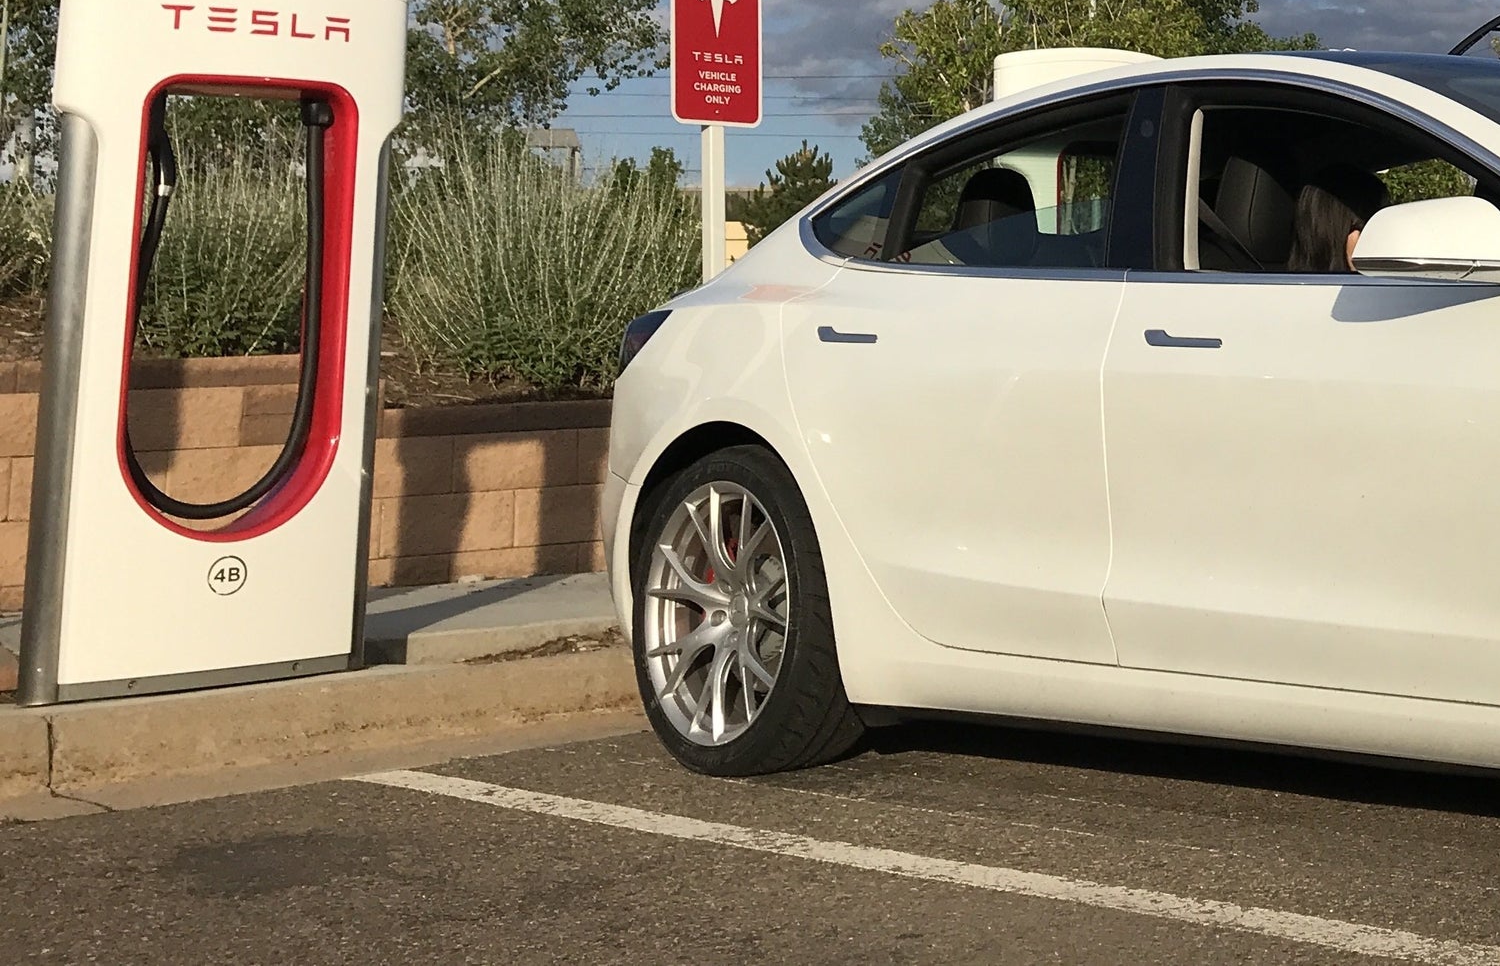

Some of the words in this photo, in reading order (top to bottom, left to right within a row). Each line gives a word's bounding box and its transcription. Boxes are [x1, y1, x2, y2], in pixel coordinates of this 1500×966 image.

[161, 4, 350, 42] TESLA
[692, 51, 743, 65] TESLA
[698, 70, 737, 82] VEHICLE
[693, 82, 742, 94] CHARGING
[705, 94, 731, 105] ONLY
[213, 567, 241, 583] 4B
